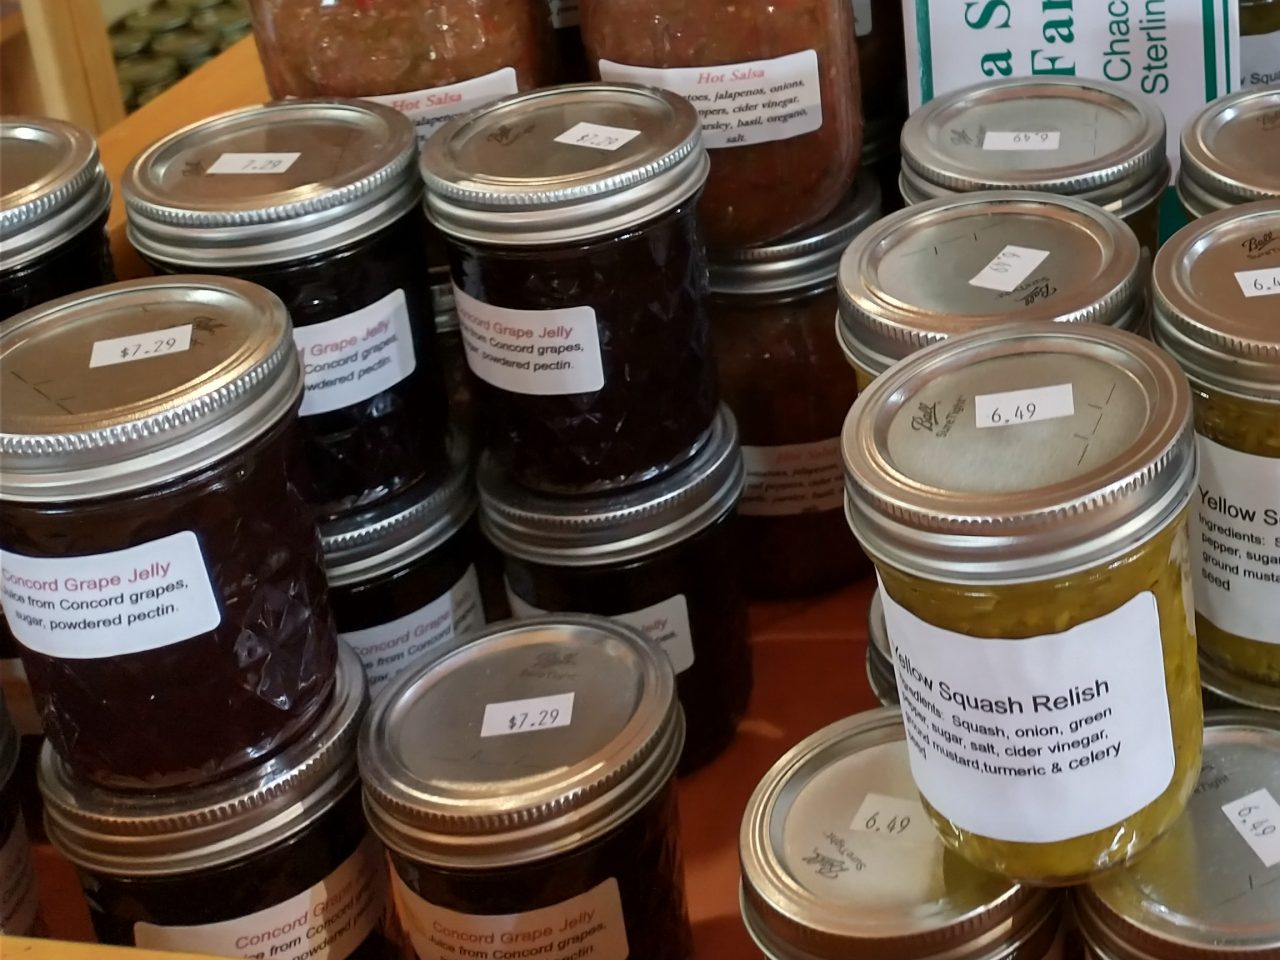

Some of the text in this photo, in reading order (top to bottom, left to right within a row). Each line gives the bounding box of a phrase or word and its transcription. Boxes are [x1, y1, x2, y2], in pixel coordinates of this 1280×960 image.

[697, 68, 765, 84] Hot Salsa
[426, 92, 462, 106] Salsa
[714, 79, 804, 102] jalapenos, onions,
[732, 96, 799, 113] cider vinegar,
[737, 116, 763, 128] basil,
[310, 319, 390, 358] Grape Jelly
[493, 322, 573, 340] Grape Jelly
[120, 337, 176, 359] $7.29
[489, 336, 584, 354] Concord grapes,
[304, 351, 358, 374] Concord
[533, 360, 573, 372] pectin.
[992, 403, 1036, 424] 6.49
[1199, 485, 1255, 523] Yellow
[1199, 512, 1265, 545] Ingredients:
[1201, 534, 1241, 558] pepper,
[1203, 551, 1239, 575] ground
[1, 562, 171, 594] Concord Grape Jelly
[1201, 568, 1230, 591] seed
[28, 578, 188, 611] from Concord grapes,
[50, 604, 179, 632] powdered pectin.
[938, 680, 1023, 714] Squash
[1032, 679, 1110, 712] Relish
[509, 708, 559, 730] $7.29
[952, 715, 1010, 740] Squash,
[1015, 725, 1063, 738] onion,
[1069, 707, 1112, 733] green
[932, 722, 1108, 757] sugar, salt, cider vinegar,
[1051, 763, 1062, 774] &
[1069, 741, 1121, 770] celery
[866, 811, 911, 834] 6.49
[1238, 806, 1276, 837] 6.49
[235, 912, 308, 950] Concord
[432, 909, 595, 944] Concord Grape Jelly
